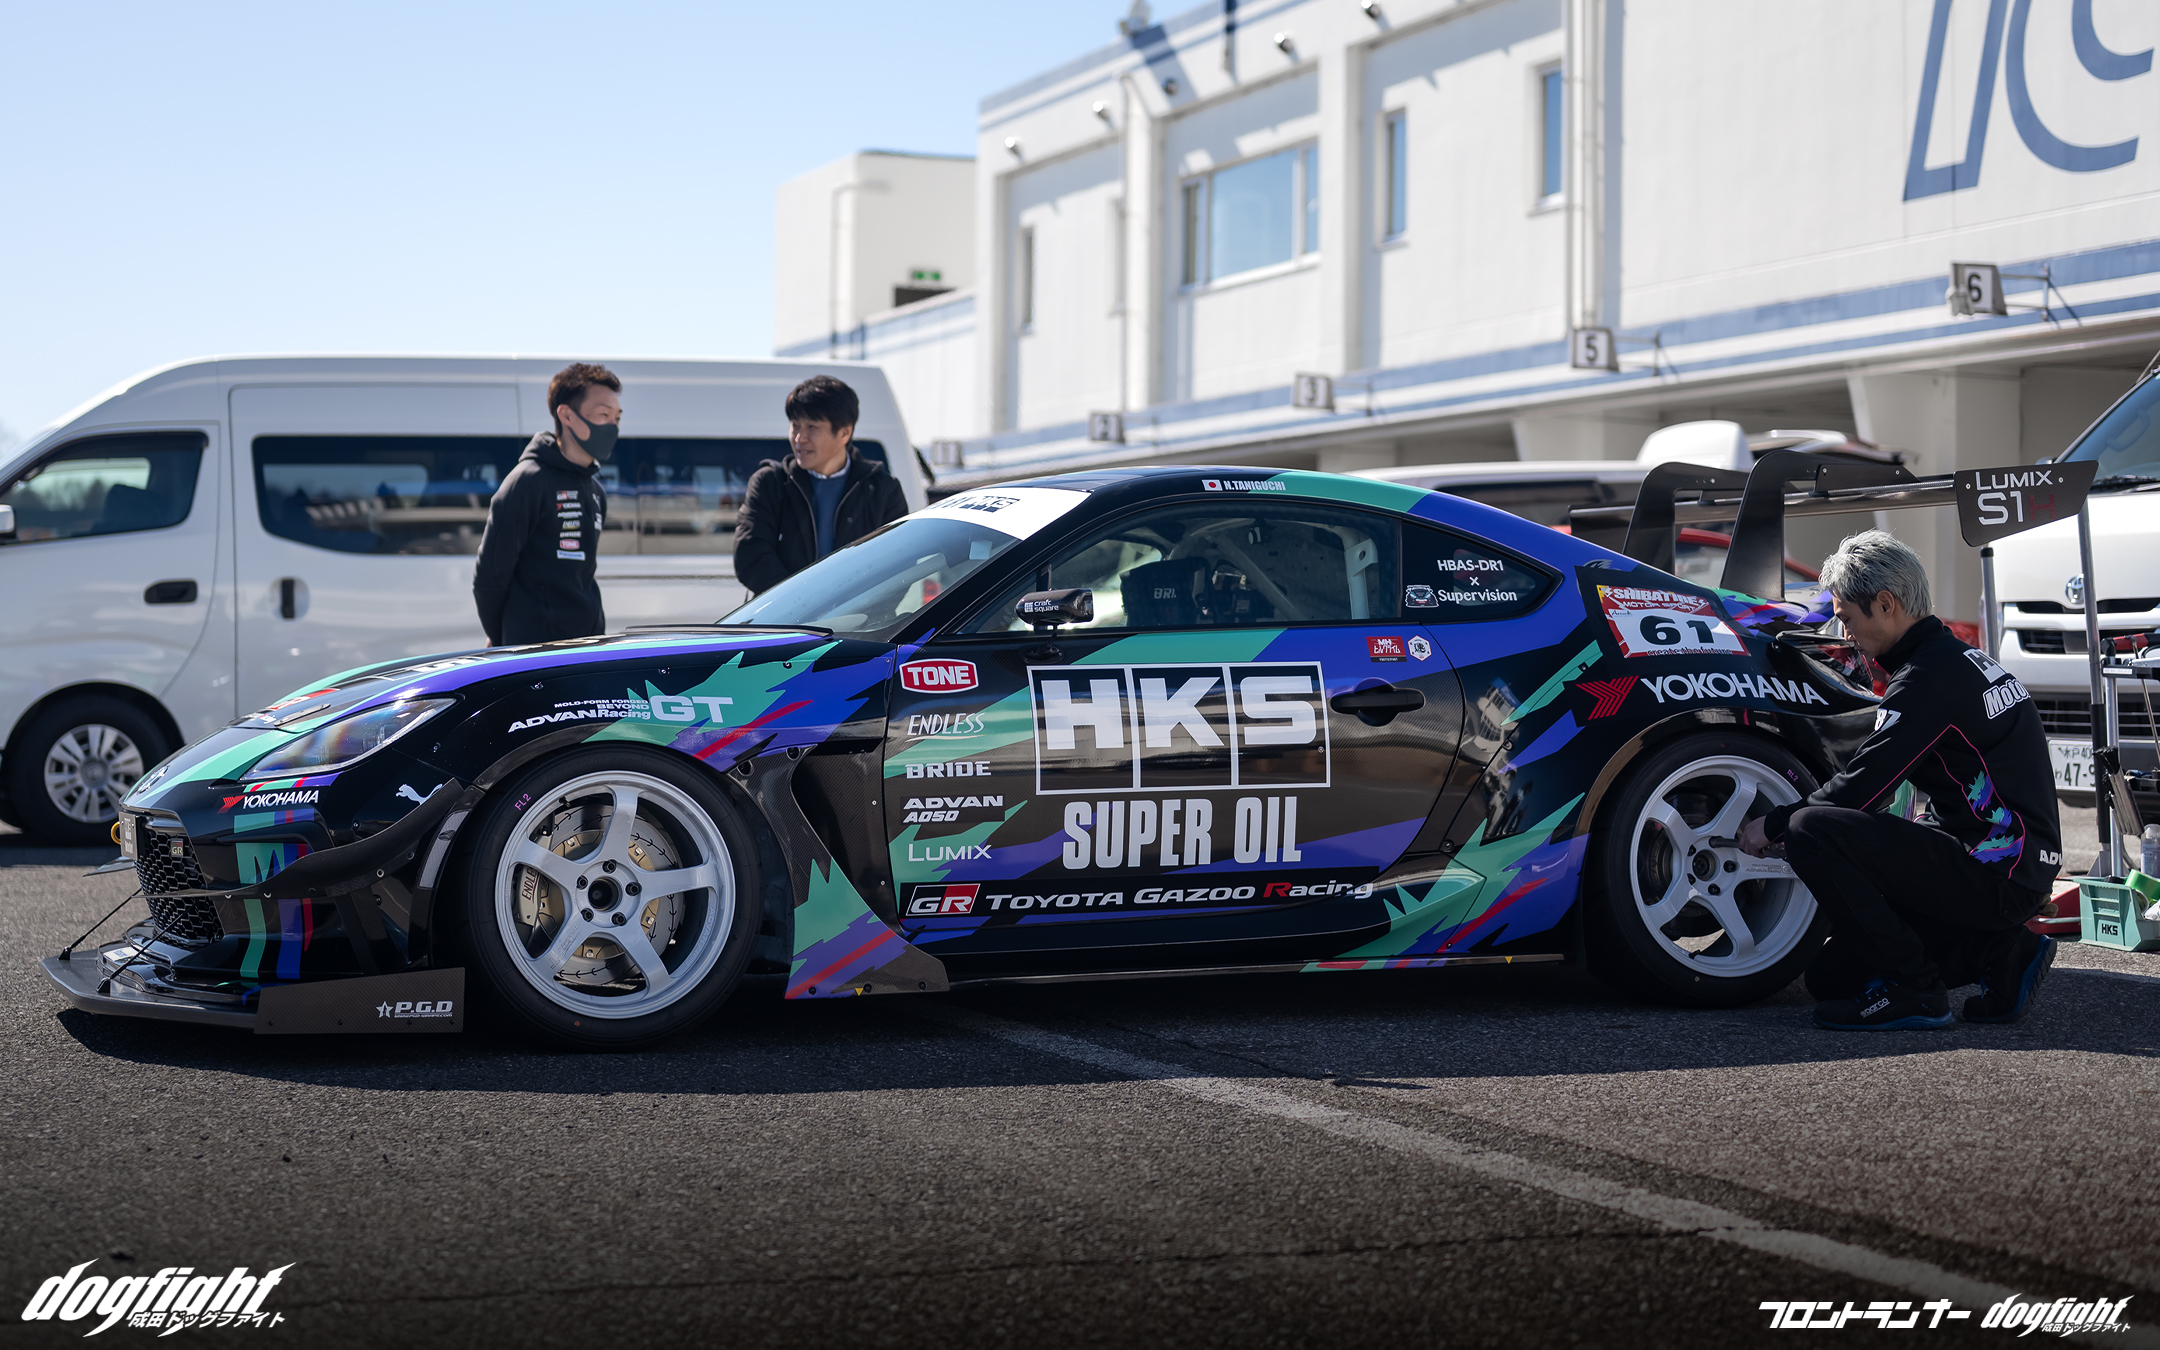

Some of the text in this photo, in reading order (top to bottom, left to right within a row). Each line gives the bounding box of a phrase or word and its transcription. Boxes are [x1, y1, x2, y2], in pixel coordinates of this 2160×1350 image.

[1967, 272, 1983, 304] 6
[1585, 333, 1598, 365] 5
[1223, 480, 1286, 491] N.TANIGUCHI
[1437, 559, 1504, 571] HBAS-DR1
[1437, 589, 1518, 604] Supervision
[1034, 605, 1060, 613] square
[1639, 615, 1715, 646] 61
[907, 665, 971, 686] TONE
[1641, 672, 1829, 706] YOKOHAMA
[1983, 679, 2031, 719] Moto
[554, 699, 609, 708] MOLD-FORM
[649, 695, 733, 723] GT
[1041, 675, 1317, 750] HKS
[906, 713, 985, 736] ENDLESS
[1874, 708, 1902, 731] 87
[905, 761, 992, 779] BRIDE
[1786, 769, 1799, 782] RL2
[243, 790, 320, 809] YOKOHAMA
[514, 793, 532, 811] FL2
[903, 795, 1004, 810] ADVAN
[1062, 796, 1302, 870] SUPER OIL
[172, 846, 183, 855] GR
[522, 867, 536, 900] ENDLE
[911, 879, 1374, 913] GR TOYOTA GAZOO Racing
[2101, 923, 2118, 936] HKS
[395, 1001, 453, 1013] P.G.D
[1860, 997, 1889, 1017] sparco
